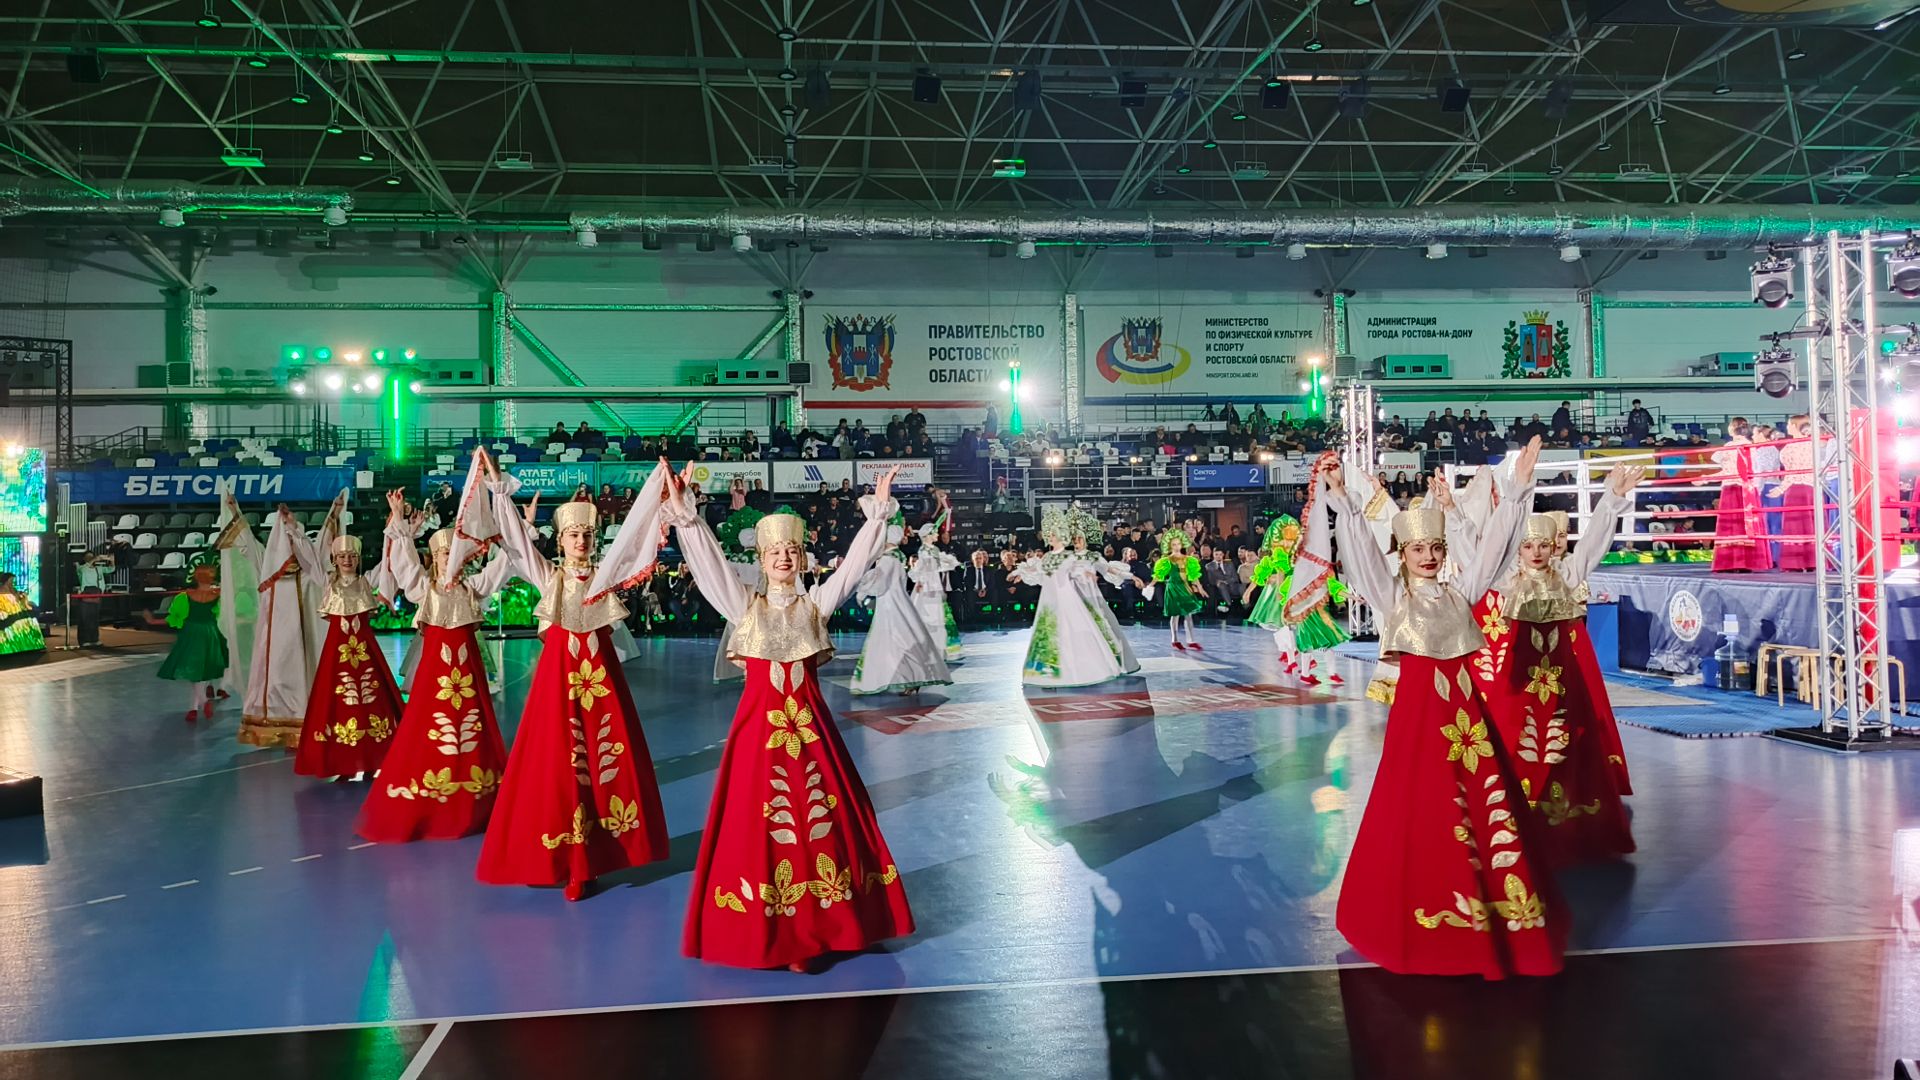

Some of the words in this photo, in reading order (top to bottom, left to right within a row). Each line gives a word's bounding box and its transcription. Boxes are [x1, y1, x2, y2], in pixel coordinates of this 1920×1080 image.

[1205, 317, 1269, 327] МИНИСТЕРСТВО
[1367, 317, 1437, 327] АДМИНИСТРАЦИЯ
[928, 324, 1045, 339] ПРАВИТЕЛЬСТВО
[1205, 330, 1217, 340] ПО
[1218, 328, 1273, 340] ФИЗИЧЕСКОЙ
[1274, 330, 1313, 339] КУЛЬТУРЕ
[1367, 330, 1399, 339] ГОРОДА
[1401, 329, 1473, 339] РОСТОВА-НА-ДОНУ
[928, 343, 1020, 361] РОСТОВСКОЙ
[1205, 343, 1212, 352] И
[1213, 343, 1245, 352] СПОРТУ
[1205, 353, 1258, 364] РОСТОВСКОЙ
[1260, 355, 1296, 364] ОБЛАСТИ
[928, 368, 993, 383] ОБЛАСТИ
[518, 469, 556, 478] АТЛЕТ
[1193, 468, 1217, 478] Сектор
[1249, 468, 1260, 483] 2
[124, 474, 283, 497] БЕТСИТИ
[523, 478, 556, 487] СИТИ
